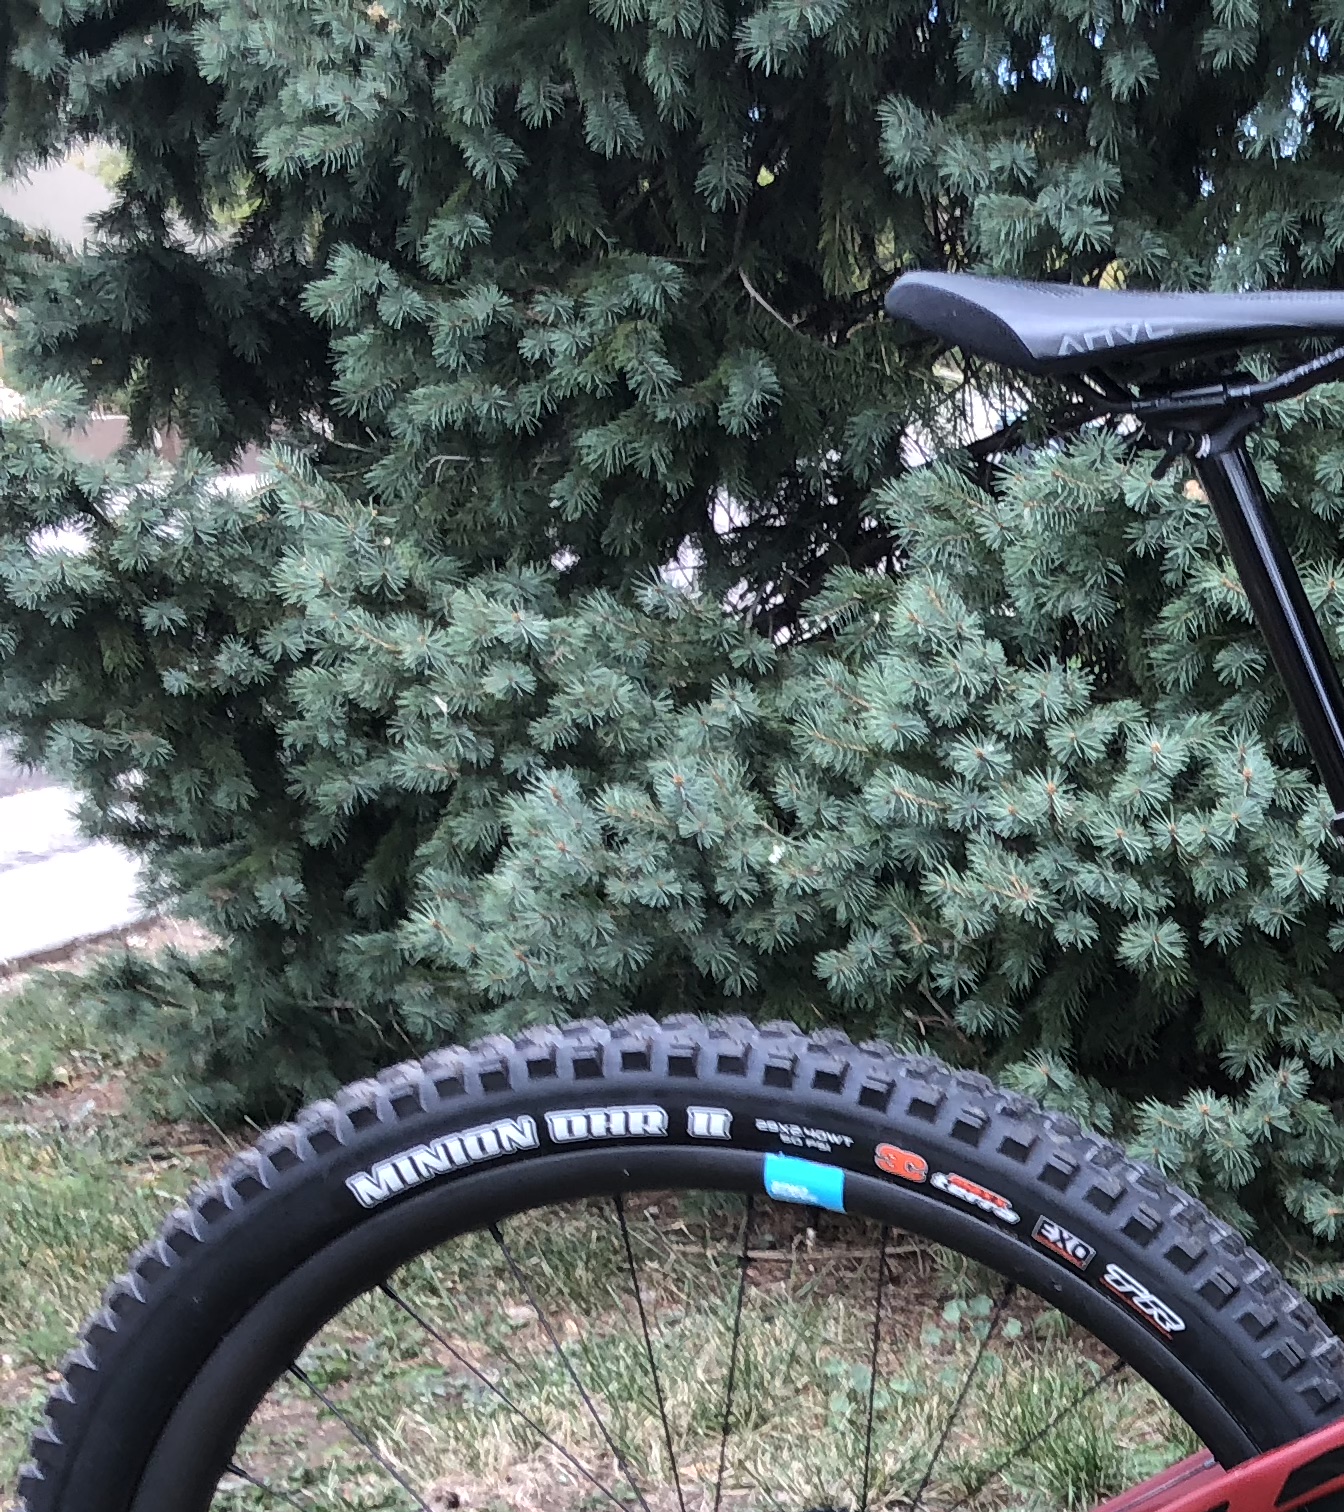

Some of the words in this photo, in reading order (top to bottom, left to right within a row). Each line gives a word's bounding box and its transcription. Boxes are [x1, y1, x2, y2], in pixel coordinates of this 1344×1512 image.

[346, 1115, 540, 1209] MINION
[544, 1104, 669, 1143] DHR
[687, 1106, 733, 1140] II
[1040, 1218, 1092, 1262] EXO
